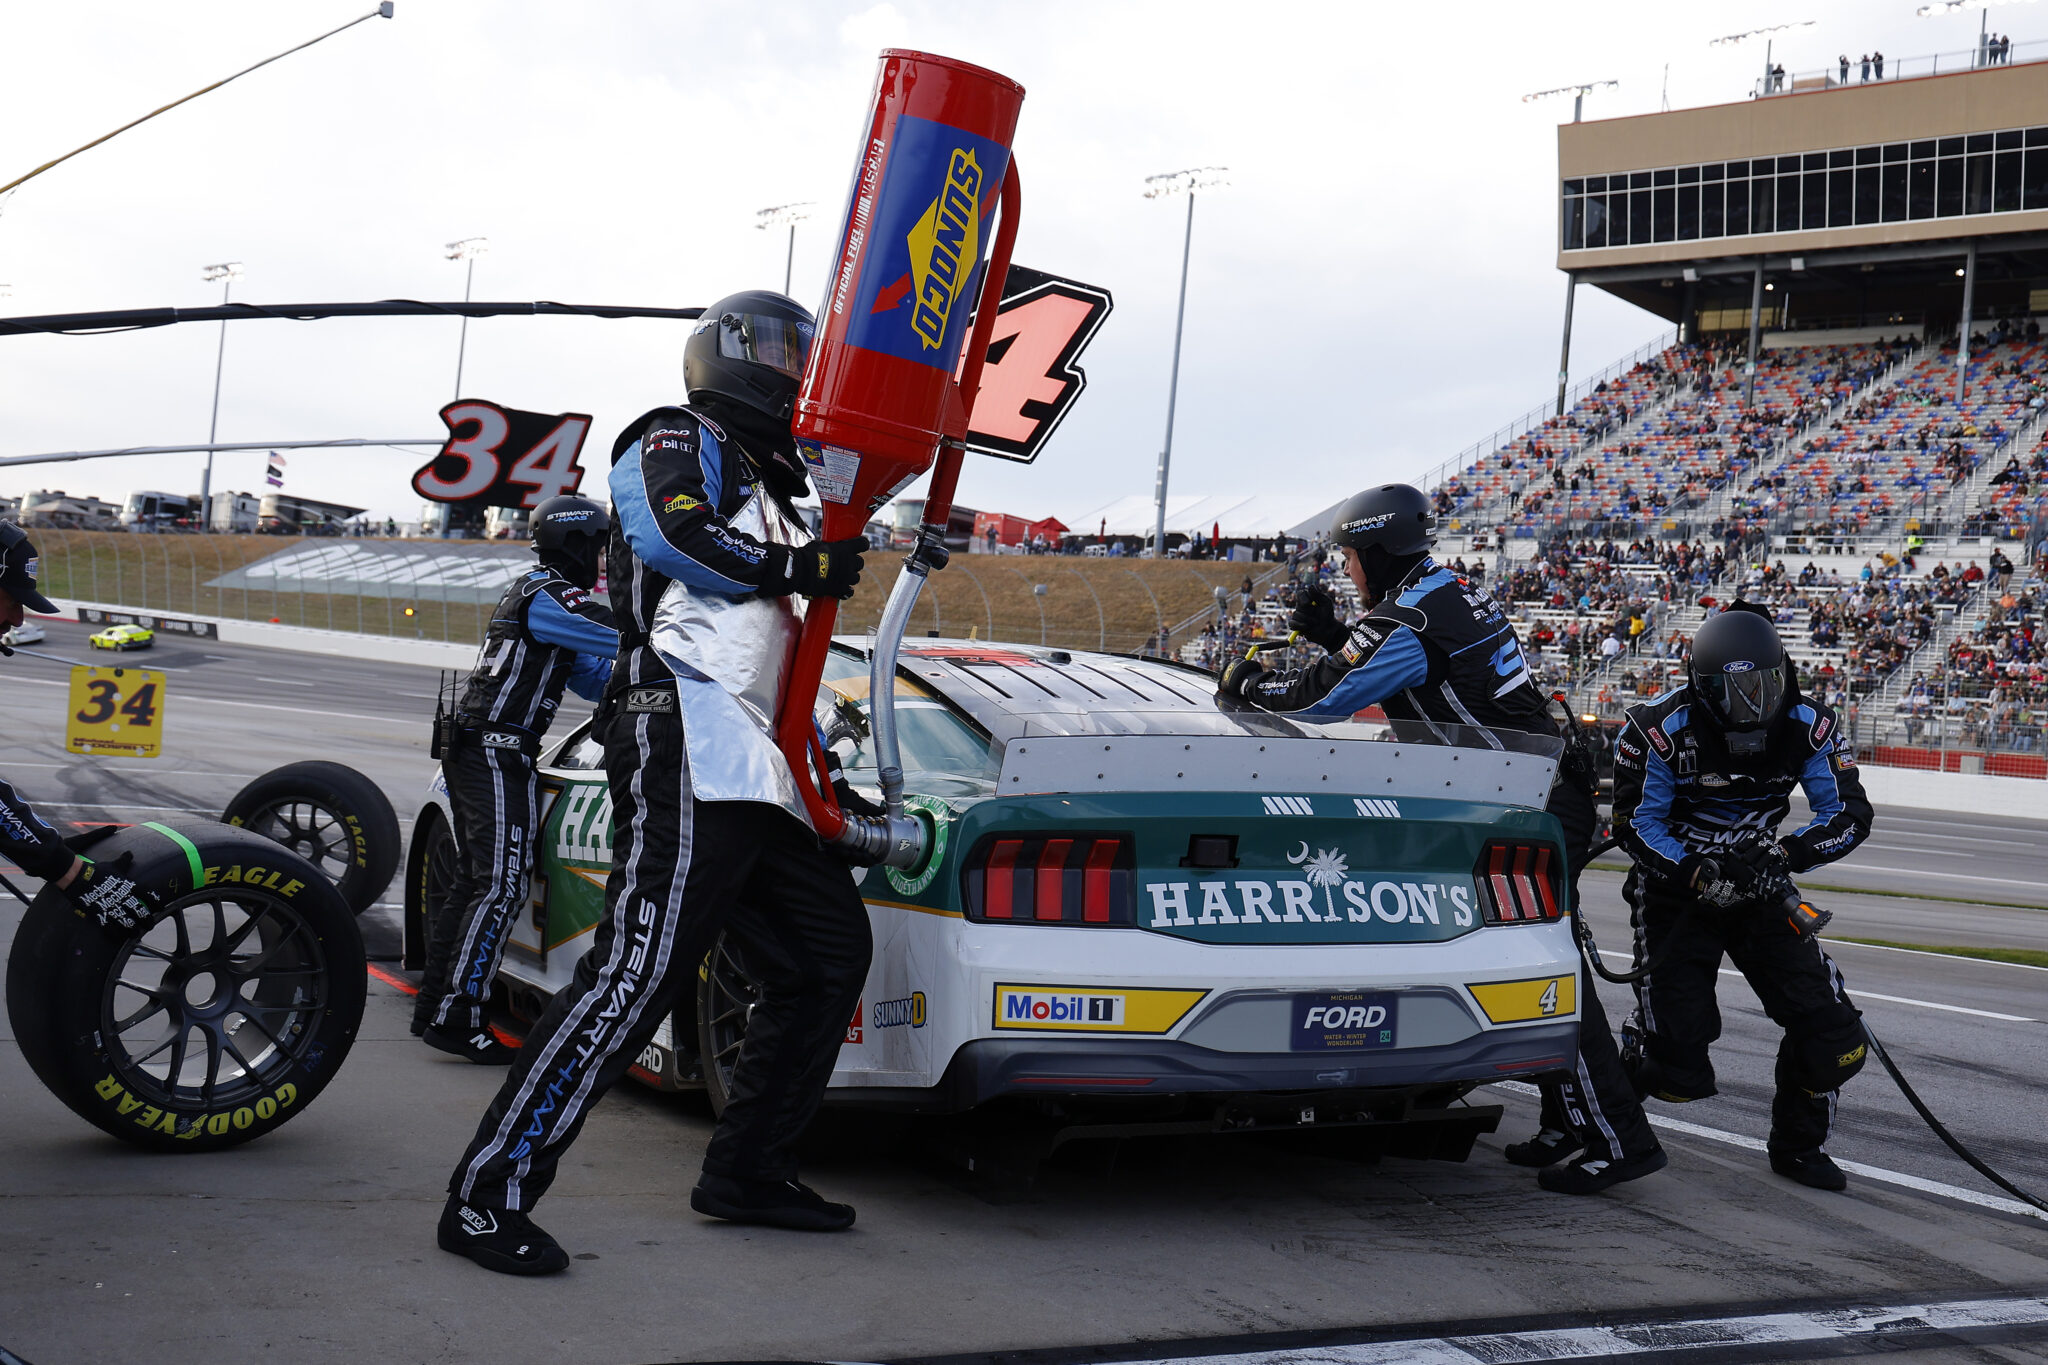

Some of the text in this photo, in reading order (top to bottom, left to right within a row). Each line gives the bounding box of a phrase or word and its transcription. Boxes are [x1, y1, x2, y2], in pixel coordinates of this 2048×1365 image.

[914, 150, 982, 348] SUNOCO
[833, 260, 853, 315] OFFICIAL
[847, 227, 861, 258] FUEL
[954, 293, 1095, 442] 4
[645, 440, 679, 455] Mobil
[649, 429, 691, 442] FORD
[416, 402, 589, 507] 34
[546, 510, 596, 521] STEWART
[665, 498, 699, 513] SUNOC
[1341, 512, 1396, 530] STEWART
[704, 523, 769, 560] STEWAR
[1357, 622, 1383, 642] NASCAR
[76, 679, 157, 727] 34
[0, 799, 42, 845] EWART
[345, 814, 367, 869] EAGLE
[204, 864, 306, 899] EAGLE
[1007, 994, 1110, 1022] Mobil 1
[1538, 981, 1558, 1014] 4
[1304, 1006, 1387, 1029] FORD
[1381, 1032, 1390, 1041] 24
[95, 1073, 298, 1140] GOODYEAR
[460, 1206, 488, 1228] sparco
